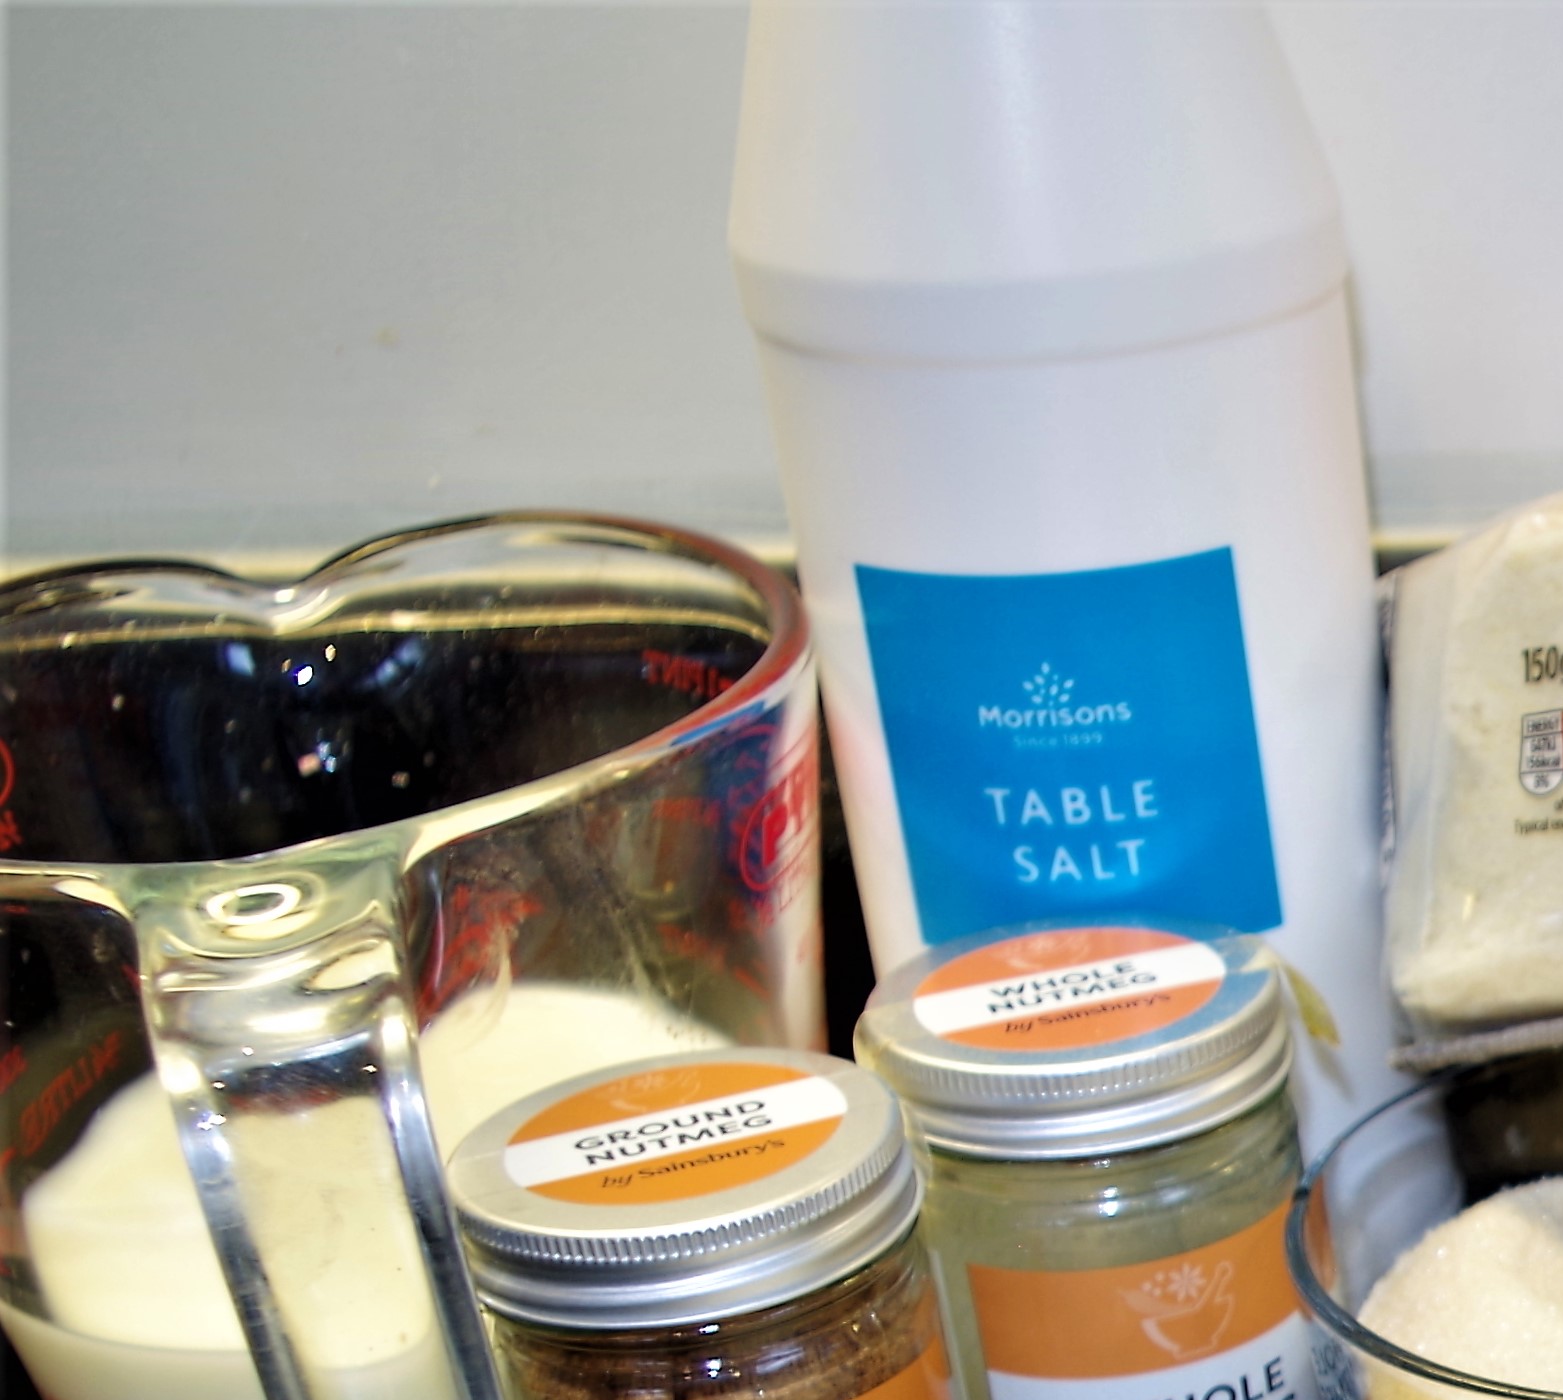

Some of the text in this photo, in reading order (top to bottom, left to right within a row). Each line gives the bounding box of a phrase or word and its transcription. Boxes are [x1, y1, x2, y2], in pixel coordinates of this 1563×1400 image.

[978, 701, 1132, 729] Morrisons
[1062, 732, 1103, 748] 1899
[984, 780, 1159, 826] TABLE
[1013, 840, 1147, 883] SALT
[987, 974, 1157, 1015] NUTMEG
[989, 960, 1137, 1000] WHOLE
[573, 1099, 767, 1152] GROUND
[584, 1113, 774, 1165] NUTMEG
[600, 1170, 635, 1190] by
